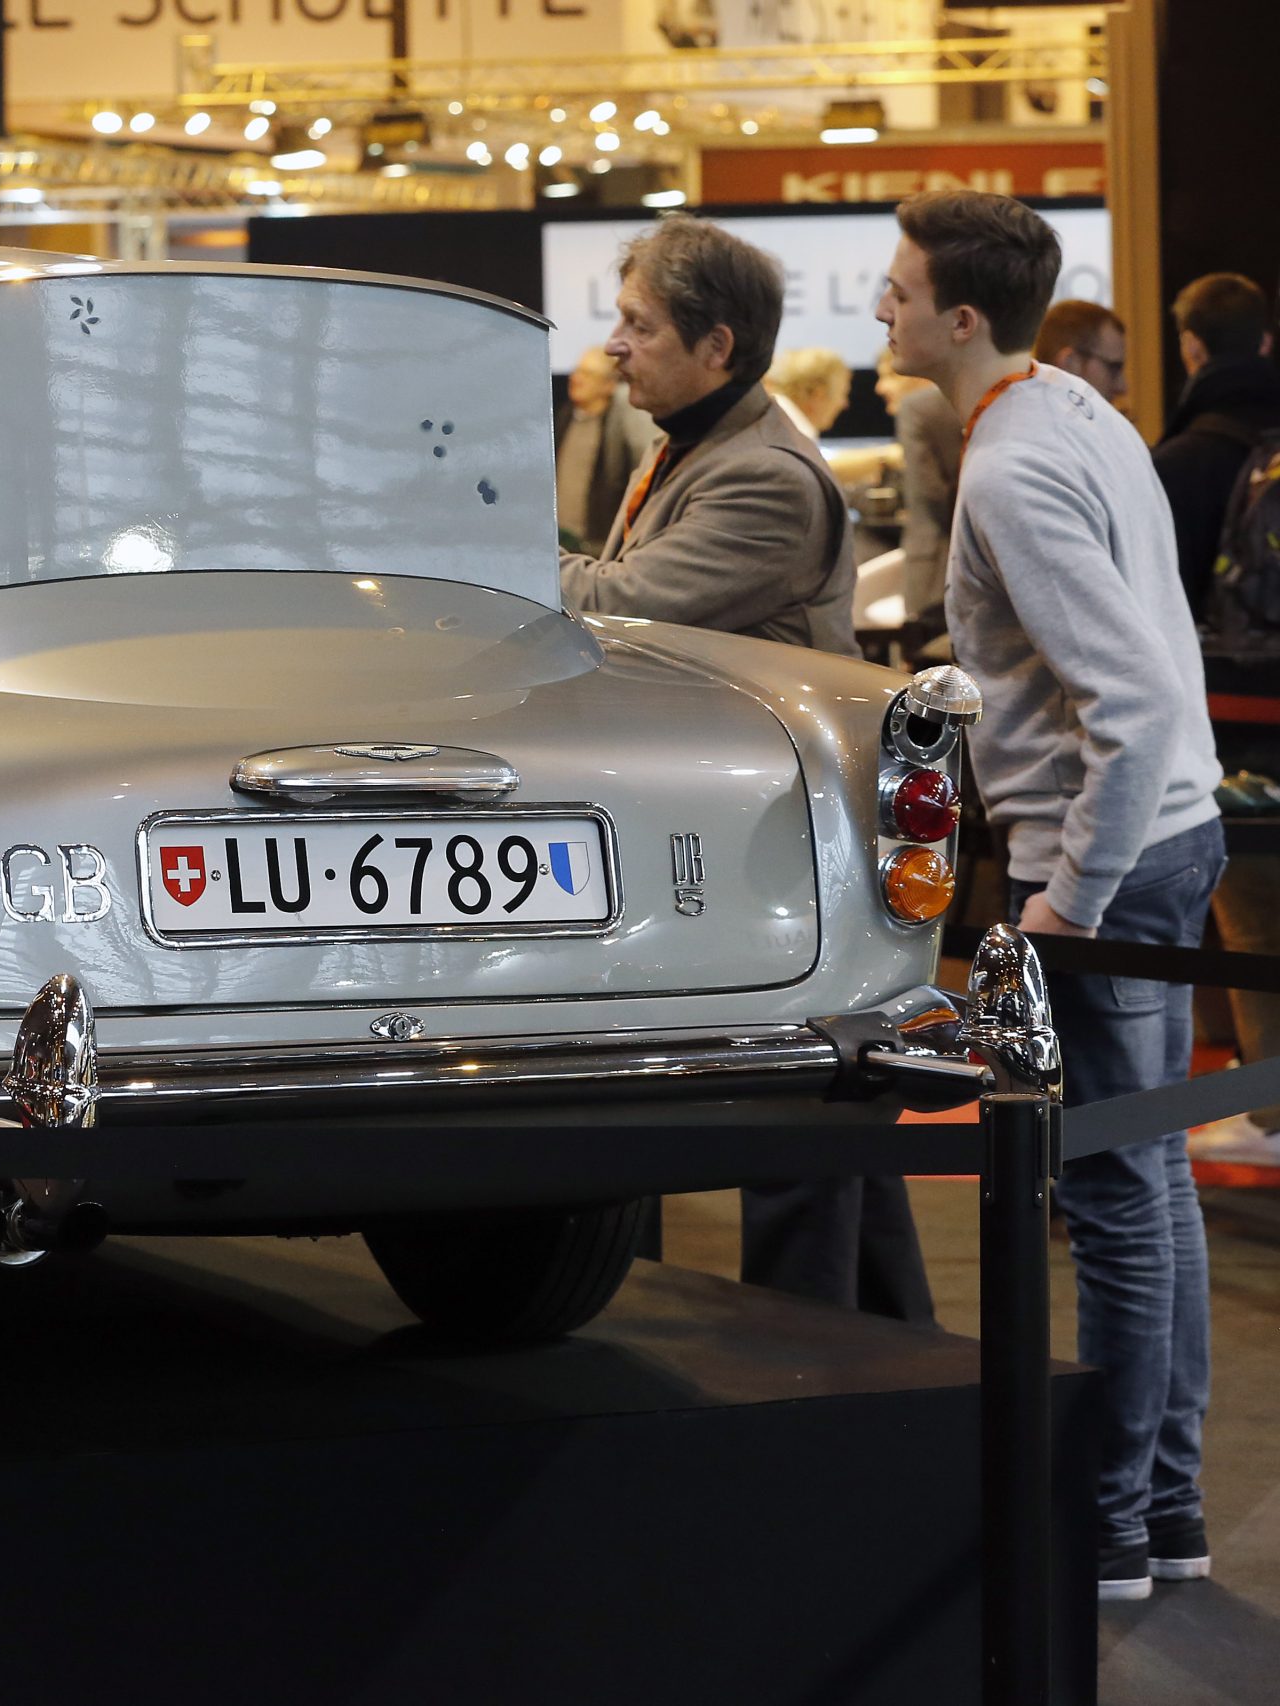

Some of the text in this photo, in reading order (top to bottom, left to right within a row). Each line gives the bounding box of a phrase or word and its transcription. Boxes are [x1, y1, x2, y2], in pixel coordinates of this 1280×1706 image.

[0, 843, 113, 923] GB
[670, 832, 706, 886] DB
[675, 888, 707, 917] 5
